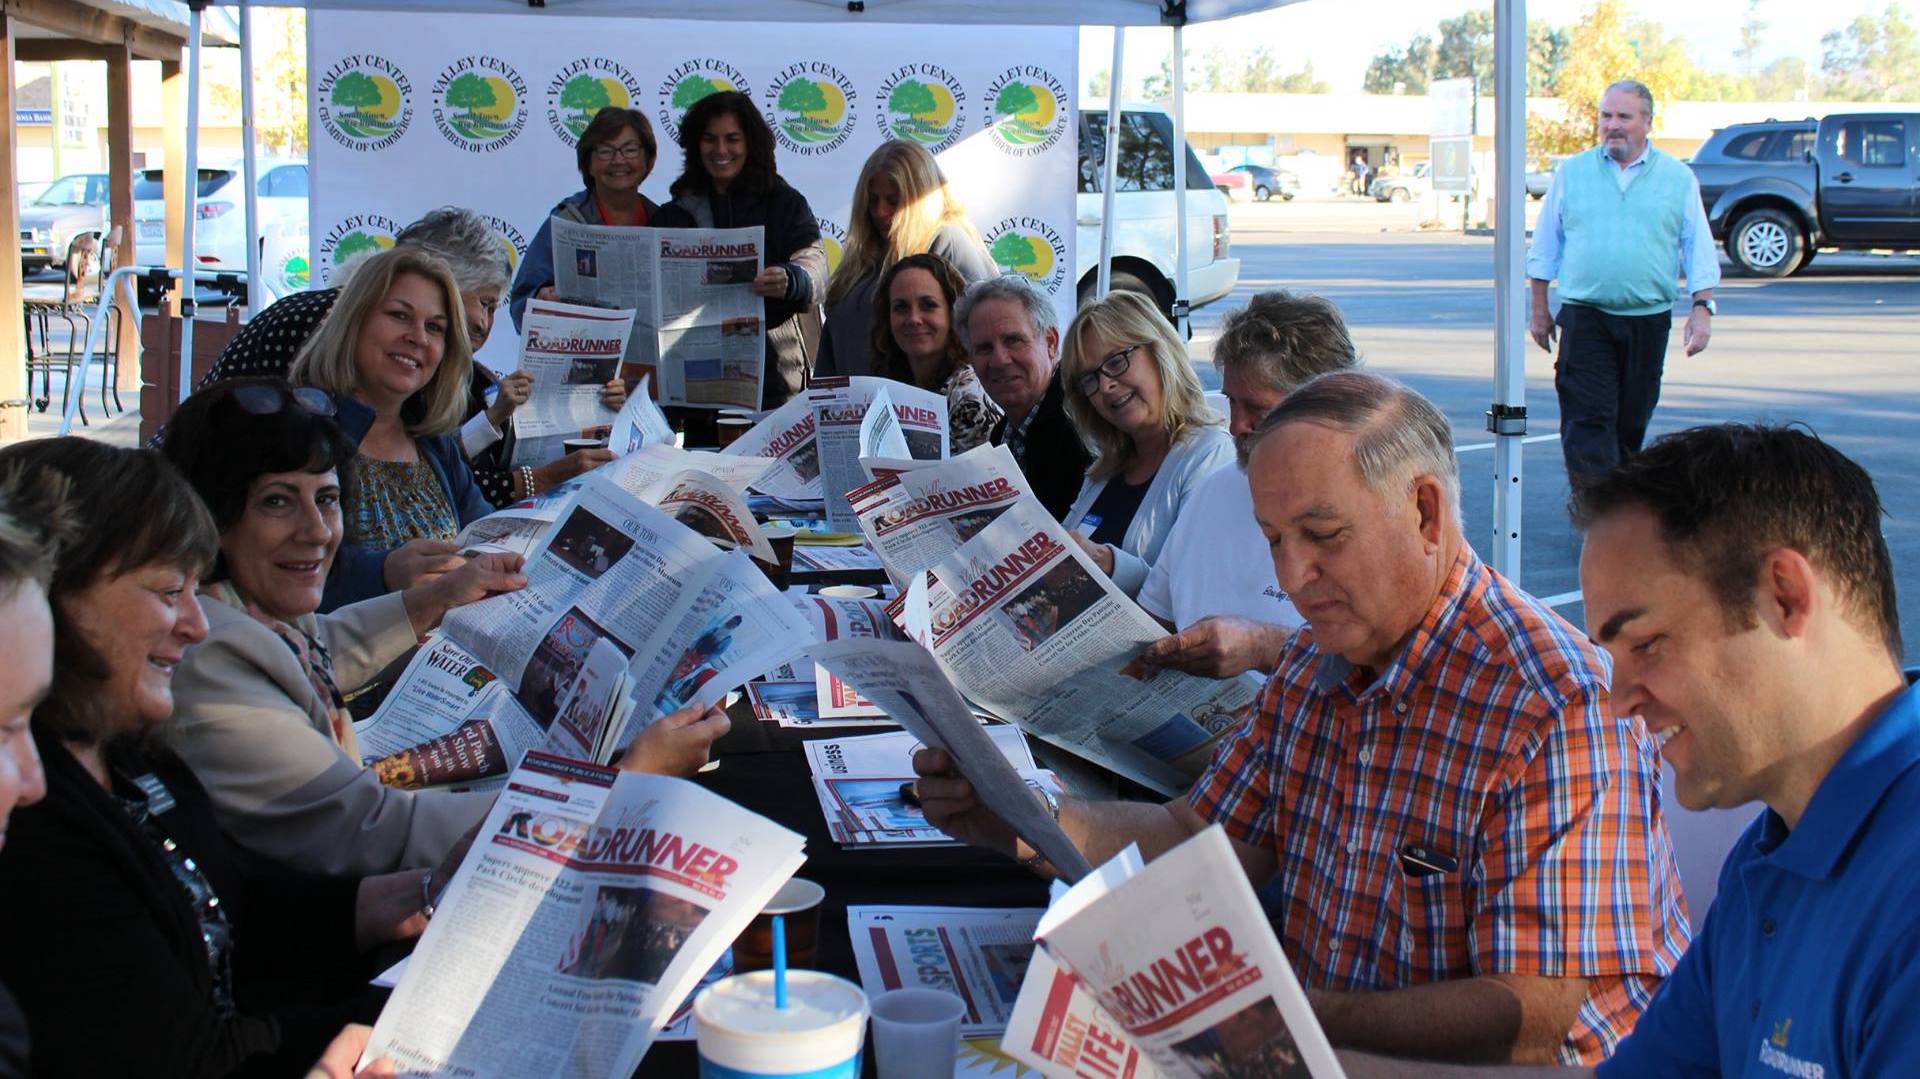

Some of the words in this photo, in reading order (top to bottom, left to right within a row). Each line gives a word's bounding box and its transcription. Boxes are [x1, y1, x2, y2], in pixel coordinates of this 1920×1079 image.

[318, 55, 361, 93] VALLEY
[365, 54, 412, 96] CENTER
[432, 56, 475, 95] VALLEY
[480, 55, 527, 97] CENTER
[547, 57, 591, 96] VALLEY
[594, 57, 642, 98] CENTER
[659, 58, 702, 97] VALLEY
[765, 62, 807, 99] VALLEY
[811, 61, 857, 101] CENTER
[876, 64, 918, 102] VALLEY
[921, 63, 966, 103] CENTER
[984, 65, 1023, 103] VALLEY
[1025, 64, 1068, 104] CENTER
[318, 107, 353, 150] CHAMBER
[371, 108, 413, 151] COMMERCE
[432, 108, 468, 151] CHAMBER
[485, 109, 528, 152] COMMERCE
[767, 112, 799, 155] CHAMBER
[815, 113, 857, 155] COMMERCE
[321, 215, 364, 253] VALLEY
[984, 217, 1018, 248] ALLEY
[1022, 217, 1065, 256] CENTER
[526, 336, 622, 352] ROADRUNNER
[873, 477, 1014, 531] ROADRUNNER
[426, 648, 468, 678] WATER
[452, 737, 471, 769] Show
[500, 809, 739, 886] ROADRUNNER
[904, 927, 953, 988] SPORTS
